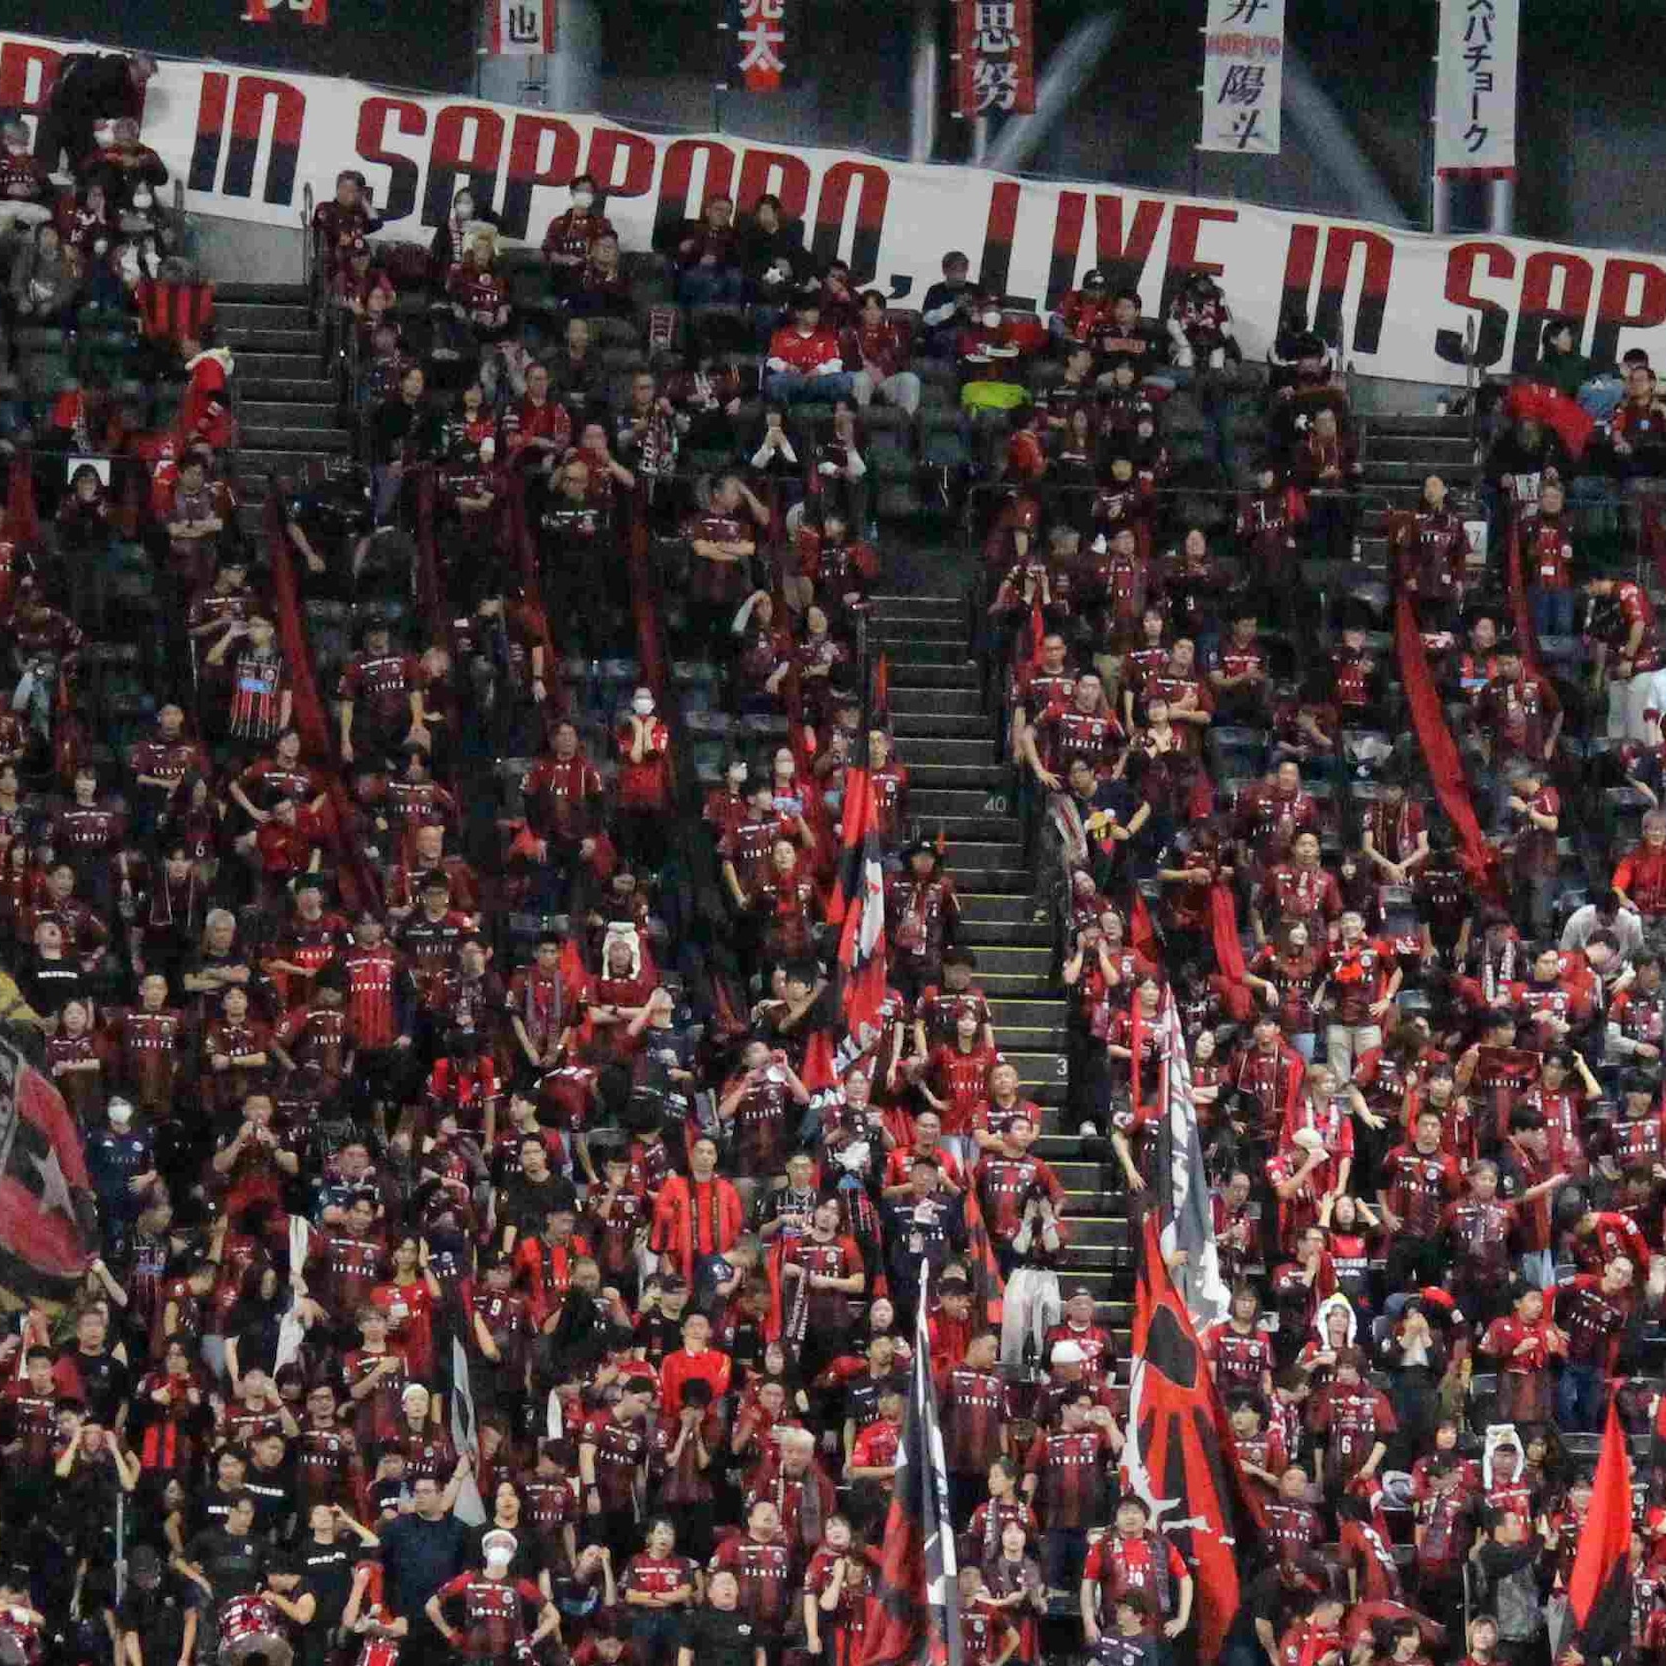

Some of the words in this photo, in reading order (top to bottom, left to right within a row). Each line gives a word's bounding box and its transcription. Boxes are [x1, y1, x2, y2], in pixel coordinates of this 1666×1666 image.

[1218, 62, 1265, 150] 陽斗
[188, 71, 307, 206] IN
[978, 182, 1238, 322] LIVE
[1277, 223, 1395, 356] IN
